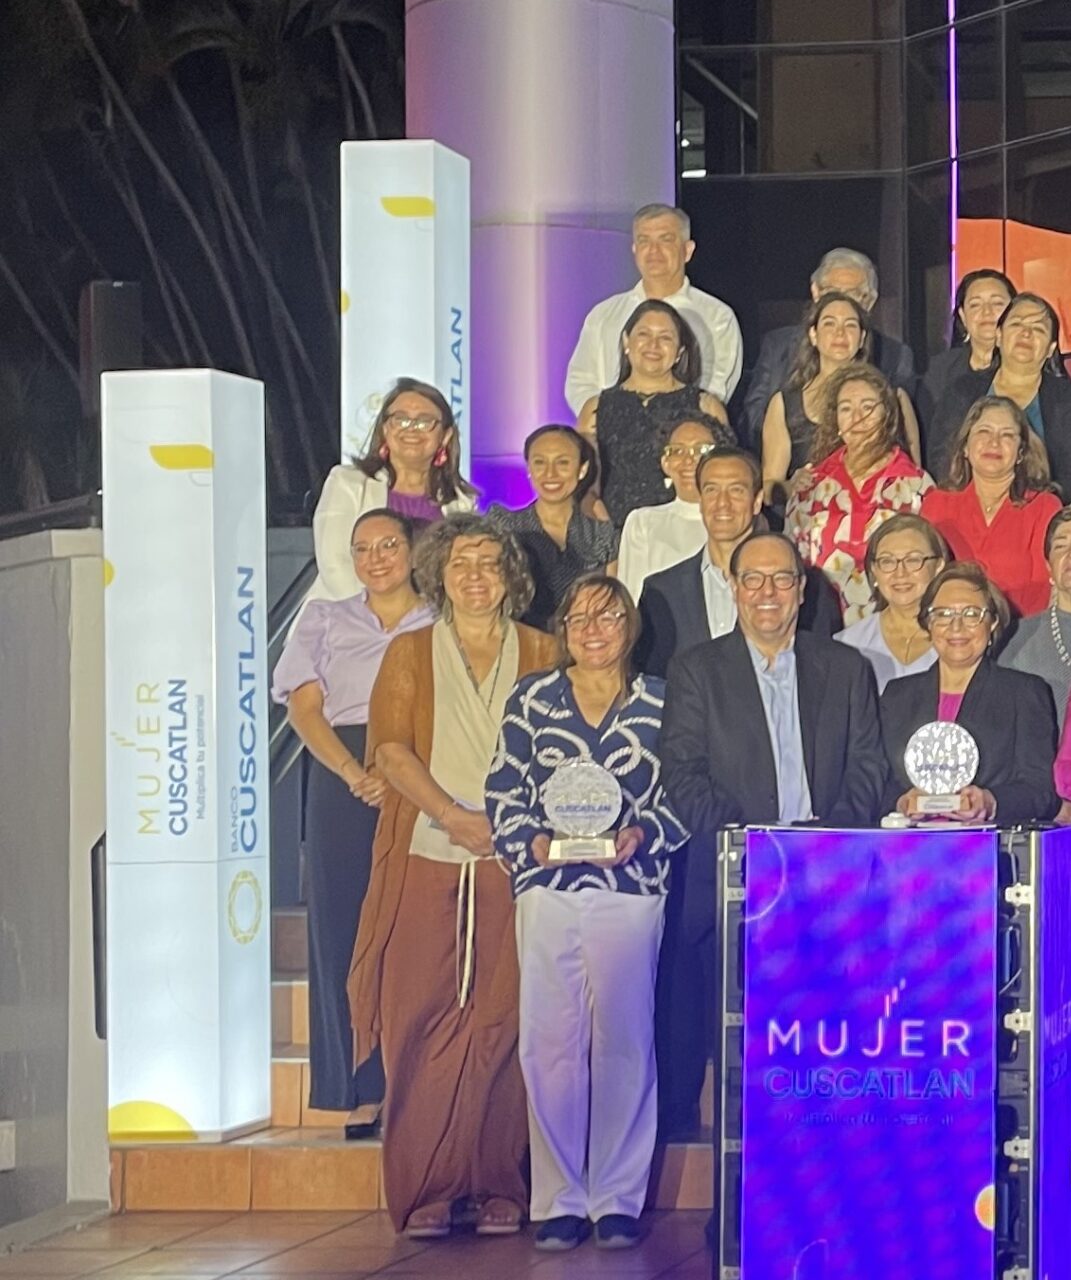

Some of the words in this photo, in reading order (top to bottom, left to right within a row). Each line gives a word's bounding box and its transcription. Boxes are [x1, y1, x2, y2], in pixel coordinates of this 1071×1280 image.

[195, 694, 206, 748] potencial
[237, 566, 258, 853] CUSCATLAN
[137, 682, 161, 835] MUJER
[168, 679, 188, 836] CUSCATLAN
[195, 750, 205, 762] tu
[195, 764, 206, 820] Multiplica
[231, 785, 239, 853] BANCO
[767, 1018, 971, 1058] MUJER
[764, 1067, 976, 1101] CUSCATLAN
